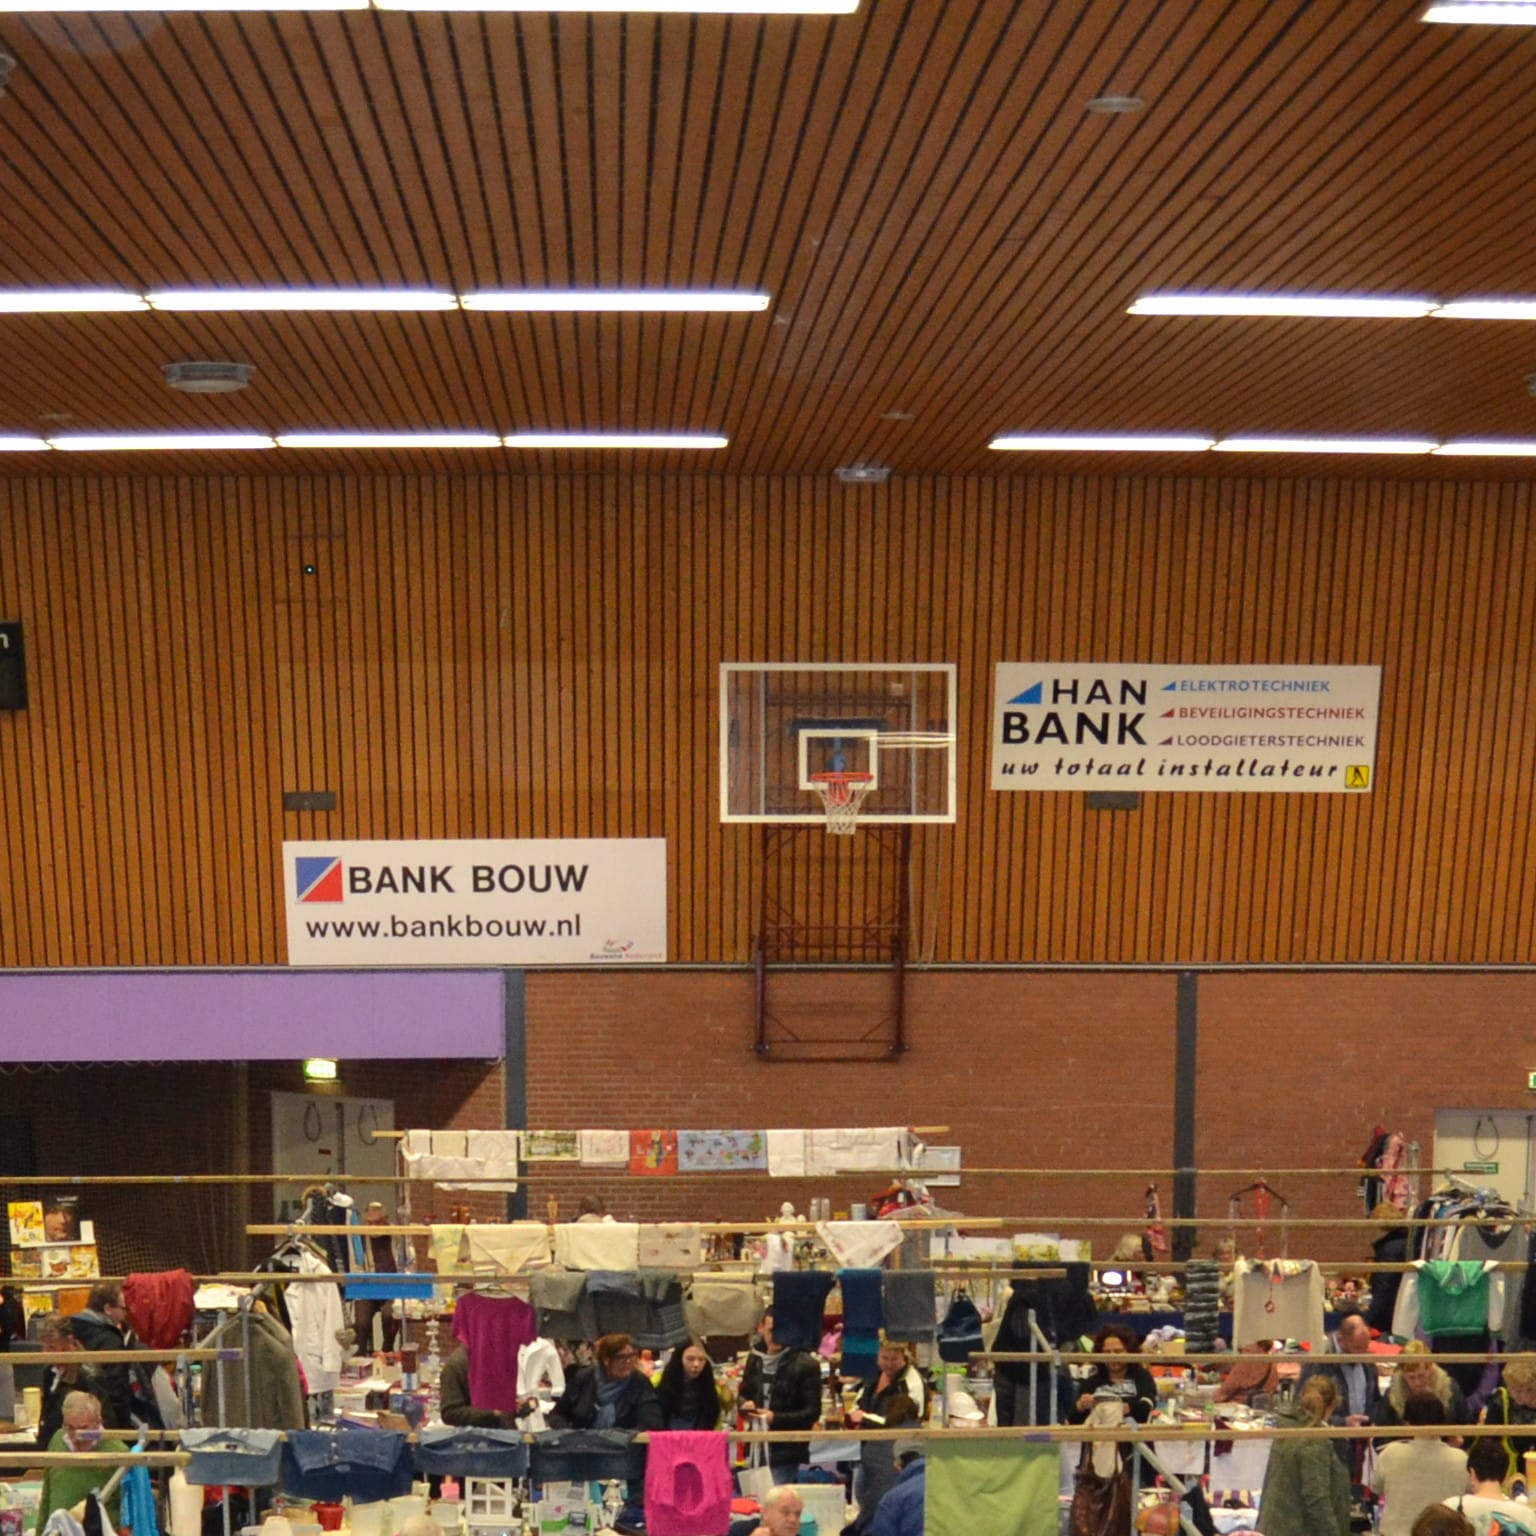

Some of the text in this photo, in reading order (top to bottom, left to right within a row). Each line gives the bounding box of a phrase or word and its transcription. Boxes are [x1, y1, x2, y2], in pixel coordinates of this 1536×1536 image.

[1052, 679, 1148, 705] HAN
[1179, 679, 1331, 692] ELEKTROTECHNIEK
[1178, 706, 1365, 720] BEVEILIGINGSTECHNIEK
[1001, 711, 1148, 746] BANK
[1177, 734, 1365, 748] LOODGIETERSTECHNIEK
[1001, 757, 1338, 778] uw totaal installateur
[348, 863, 590, 894] BANK BOUW
[305, 913, 582, 938] www.bankbouw.nl
